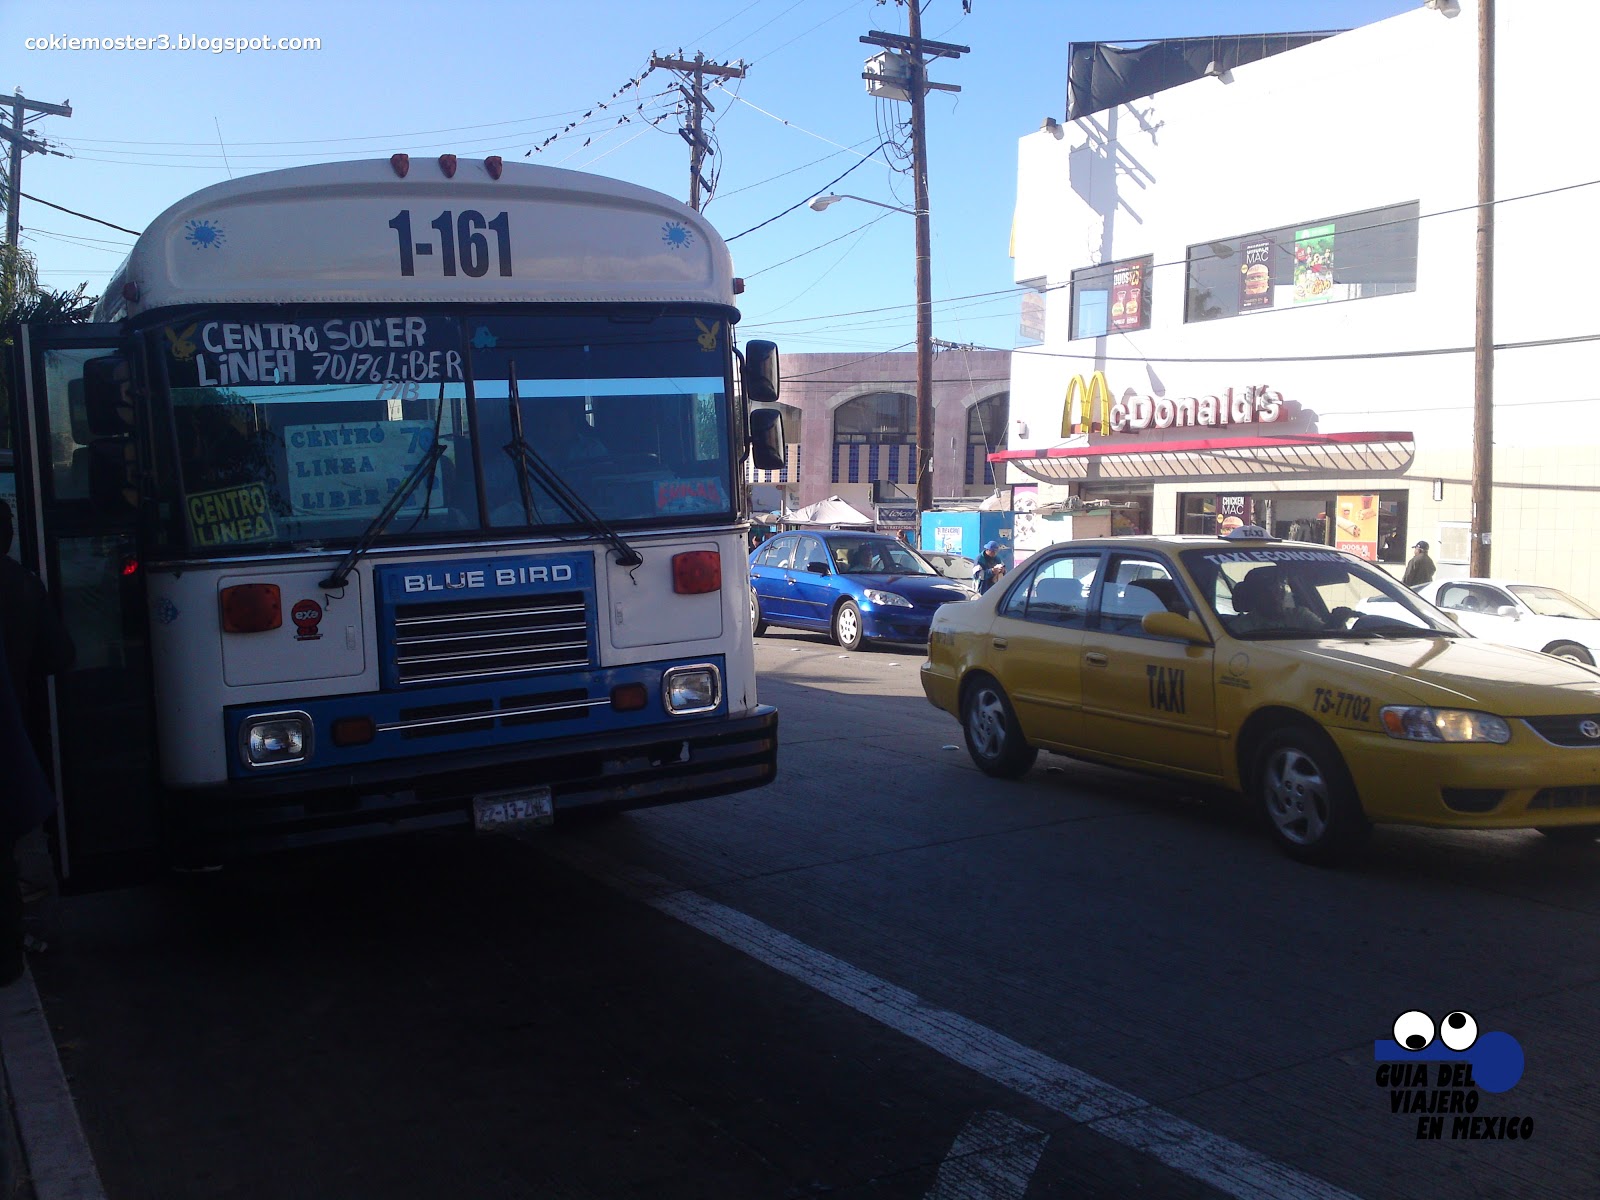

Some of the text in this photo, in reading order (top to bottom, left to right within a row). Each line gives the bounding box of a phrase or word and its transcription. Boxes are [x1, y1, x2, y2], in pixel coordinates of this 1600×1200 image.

[389, 210, 512, 277] 1-161
[1246, 251, 1269, 264] MAC
[201, 322, 318, 353] CENTRO
[1061, 374, 1283, 438] McDonald's
[291, 428, 385, 449] CENTRO
[296, 456, 375, 478] LINEA
[190, 486, 265, 525] CENTRO
[1222, 496, 1245, 505] CHICKEN
[1222, 504, 1244, 515] MAC
[198, 516, 271, 546] LINEA
[1243, 530, 1264, 538] TAXI
[1203, 552, 1250, 565] TAXI
[404, 565, 572, 593] BLUE BIRD
[1146, 664, 1187, 714] TAXI
